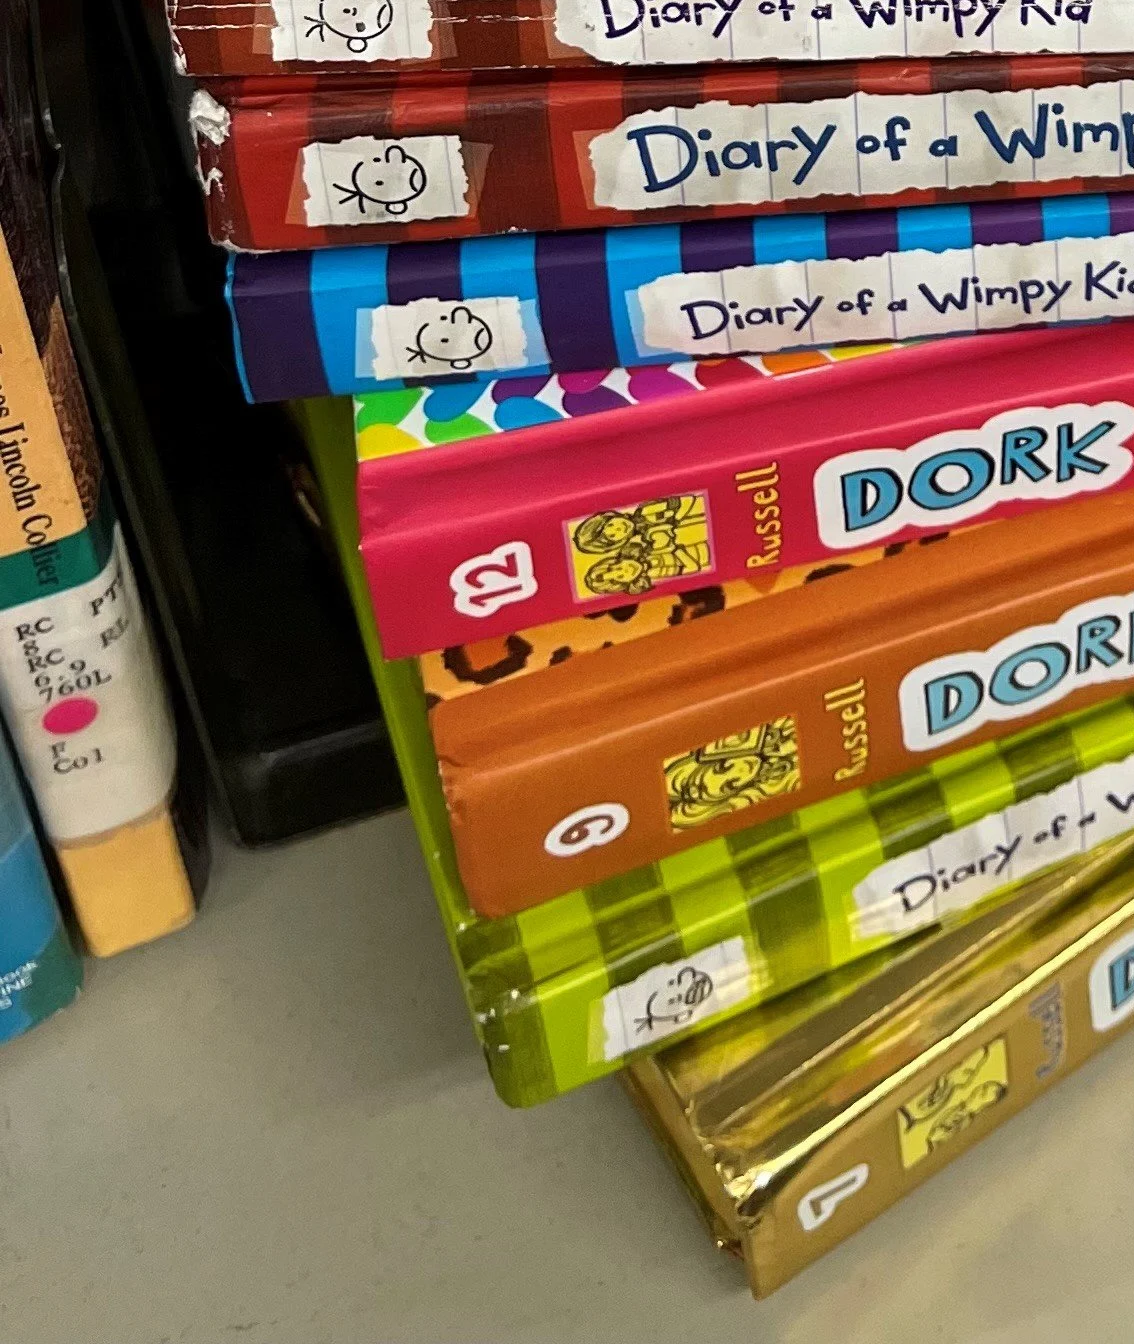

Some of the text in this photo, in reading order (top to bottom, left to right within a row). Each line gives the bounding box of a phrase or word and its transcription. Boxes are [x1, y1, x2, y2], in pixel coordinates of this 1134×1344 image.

[811, 1, 833, 21] a
[627, 124, 838, 195] Diary
[856, 116, 912, 161] of
[929, 134, 958, 159] a
[679, 297, 822, 342] Diary
[837, 290, 877, 317] of
[887, 295, 909, 314] a
[918, 272, 1073, 318] Wimpy
[838, 419, 1118, 535] DORK
[735, 461, 782, 569] Russell
[466, 548, 526, 611] 12
[15, 616, 55, 642] RC
[27, 648, 66, 673] RC
[824, 676, 869, 783] Russell
[892, 832, 1026, 917] Diary
[1033, 812, 1068, 849] of
[1078, 813, 1098, 831] a
[809, 1174, 859, 1221] 7
